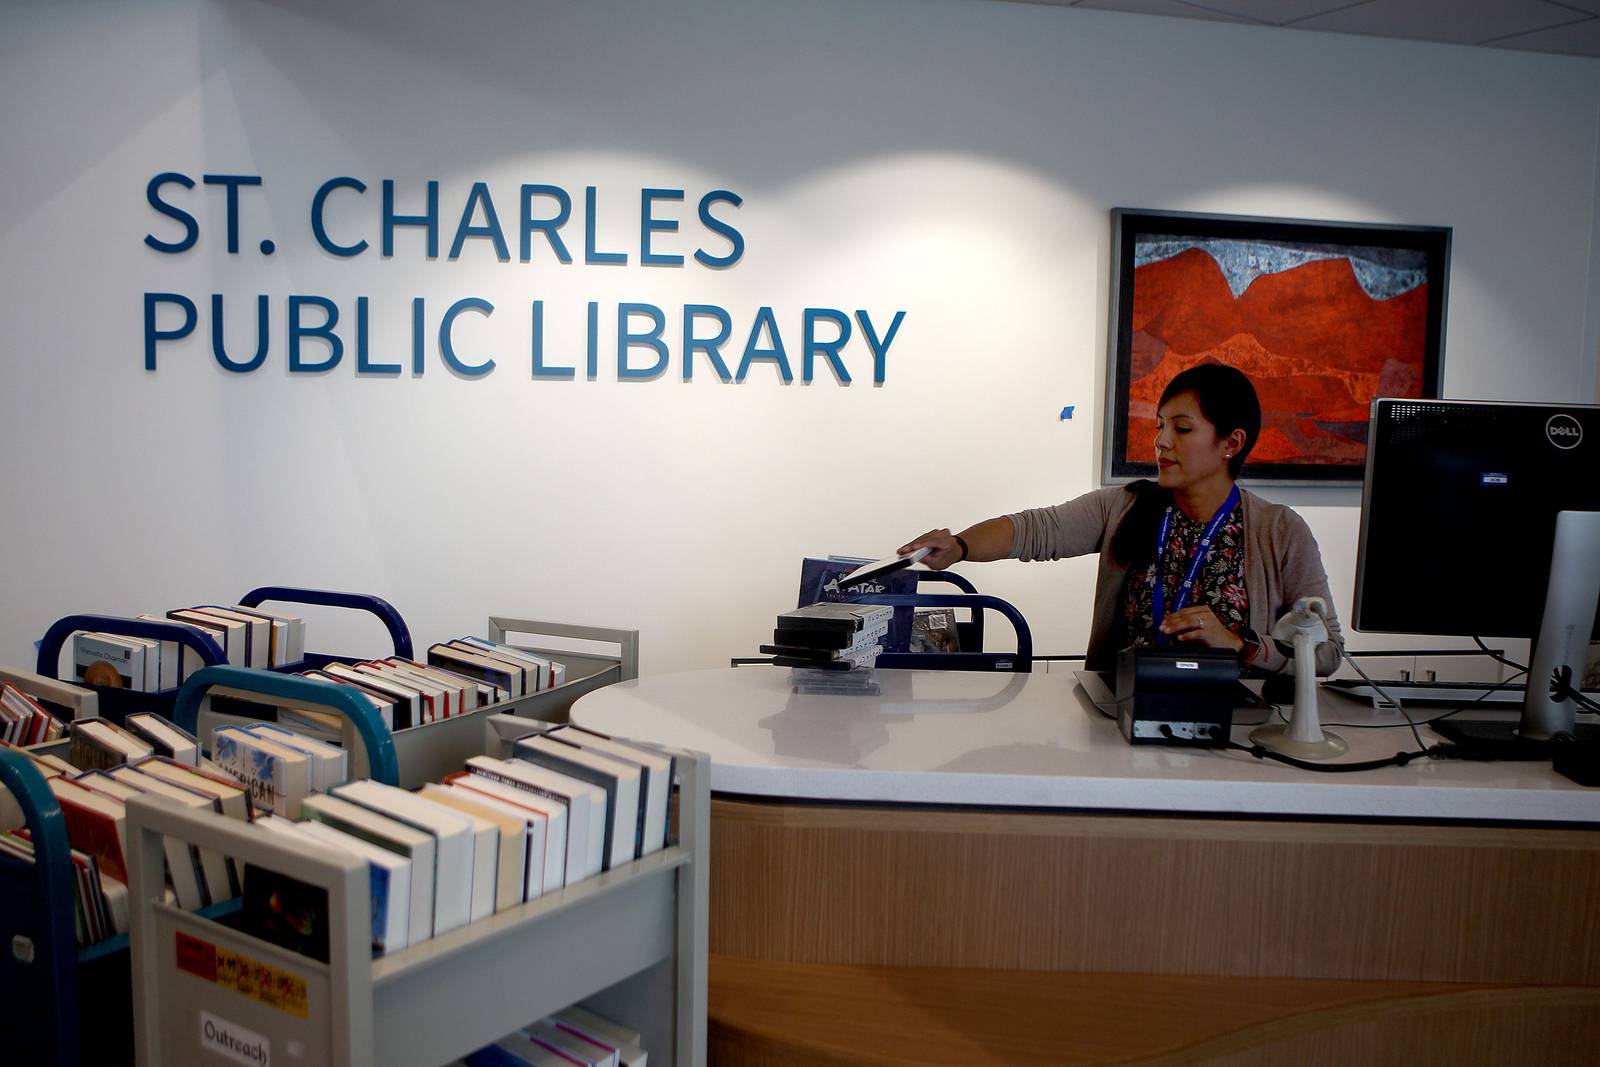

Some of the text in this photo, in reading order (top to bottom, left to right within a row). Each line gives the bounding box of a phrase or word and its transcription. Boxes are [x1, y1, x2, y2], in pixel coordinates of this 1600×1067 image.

[144, 172, 745, 270] ST. CHARLES
[144, 292, 907, 386] PUBLIC LIBRARY
[1549, 426, 1579, 437] DELL
[823, 577, 887, 594] AATAR
[204, 1020, 267, 1066] Outreach
